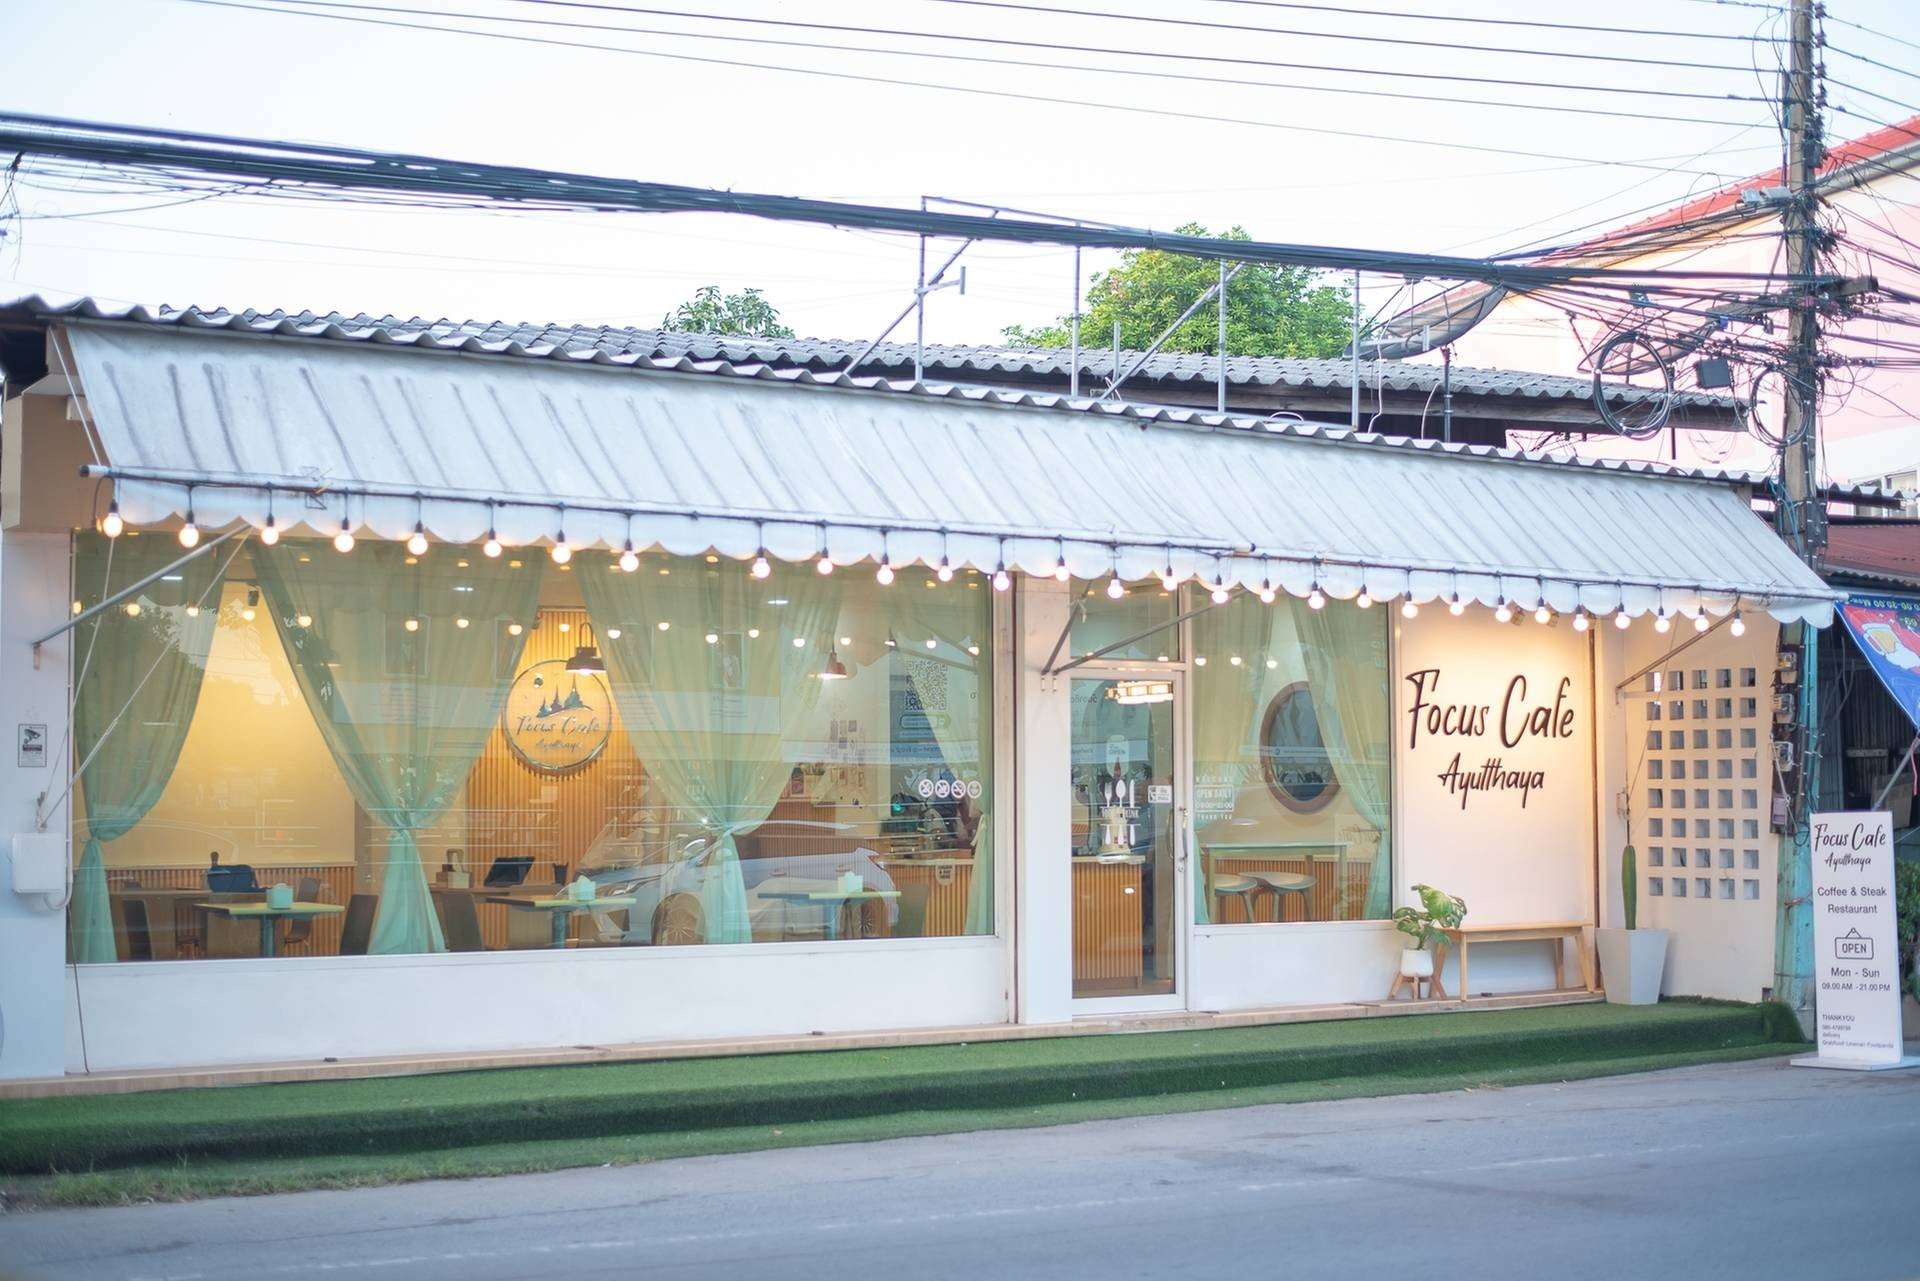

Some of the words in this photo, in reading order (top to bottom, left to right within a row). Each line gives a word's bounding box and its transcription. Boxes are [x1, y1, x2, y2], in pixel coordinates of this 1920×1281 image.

[1405, 669, 1490, 750] Focus
[1499, 674, 1575, 749] Cafe
[516, 715, 556, 736] Focus
[1437, 752, 1545, 810] Ayutthaya
[1814, 823, 1849, 852] Focus
[1851, 822, 1886, 851] Cafe
[1824, 852, 1871, 872] Ayutthaya
[1817, 886, 1847, 897] Coffee
[1850, 886, 1857, 896] &
[1860, 886, 1887, 897] Steak
[1827, 904, 1878, 914] Restaurant
[1841, 943, 1867, 953] OPEN
[1831, 967, 1851, 977] Mon
[1862, 968, 1880, 978] Sun
[1821, 982, 1840, 990] 09.00
